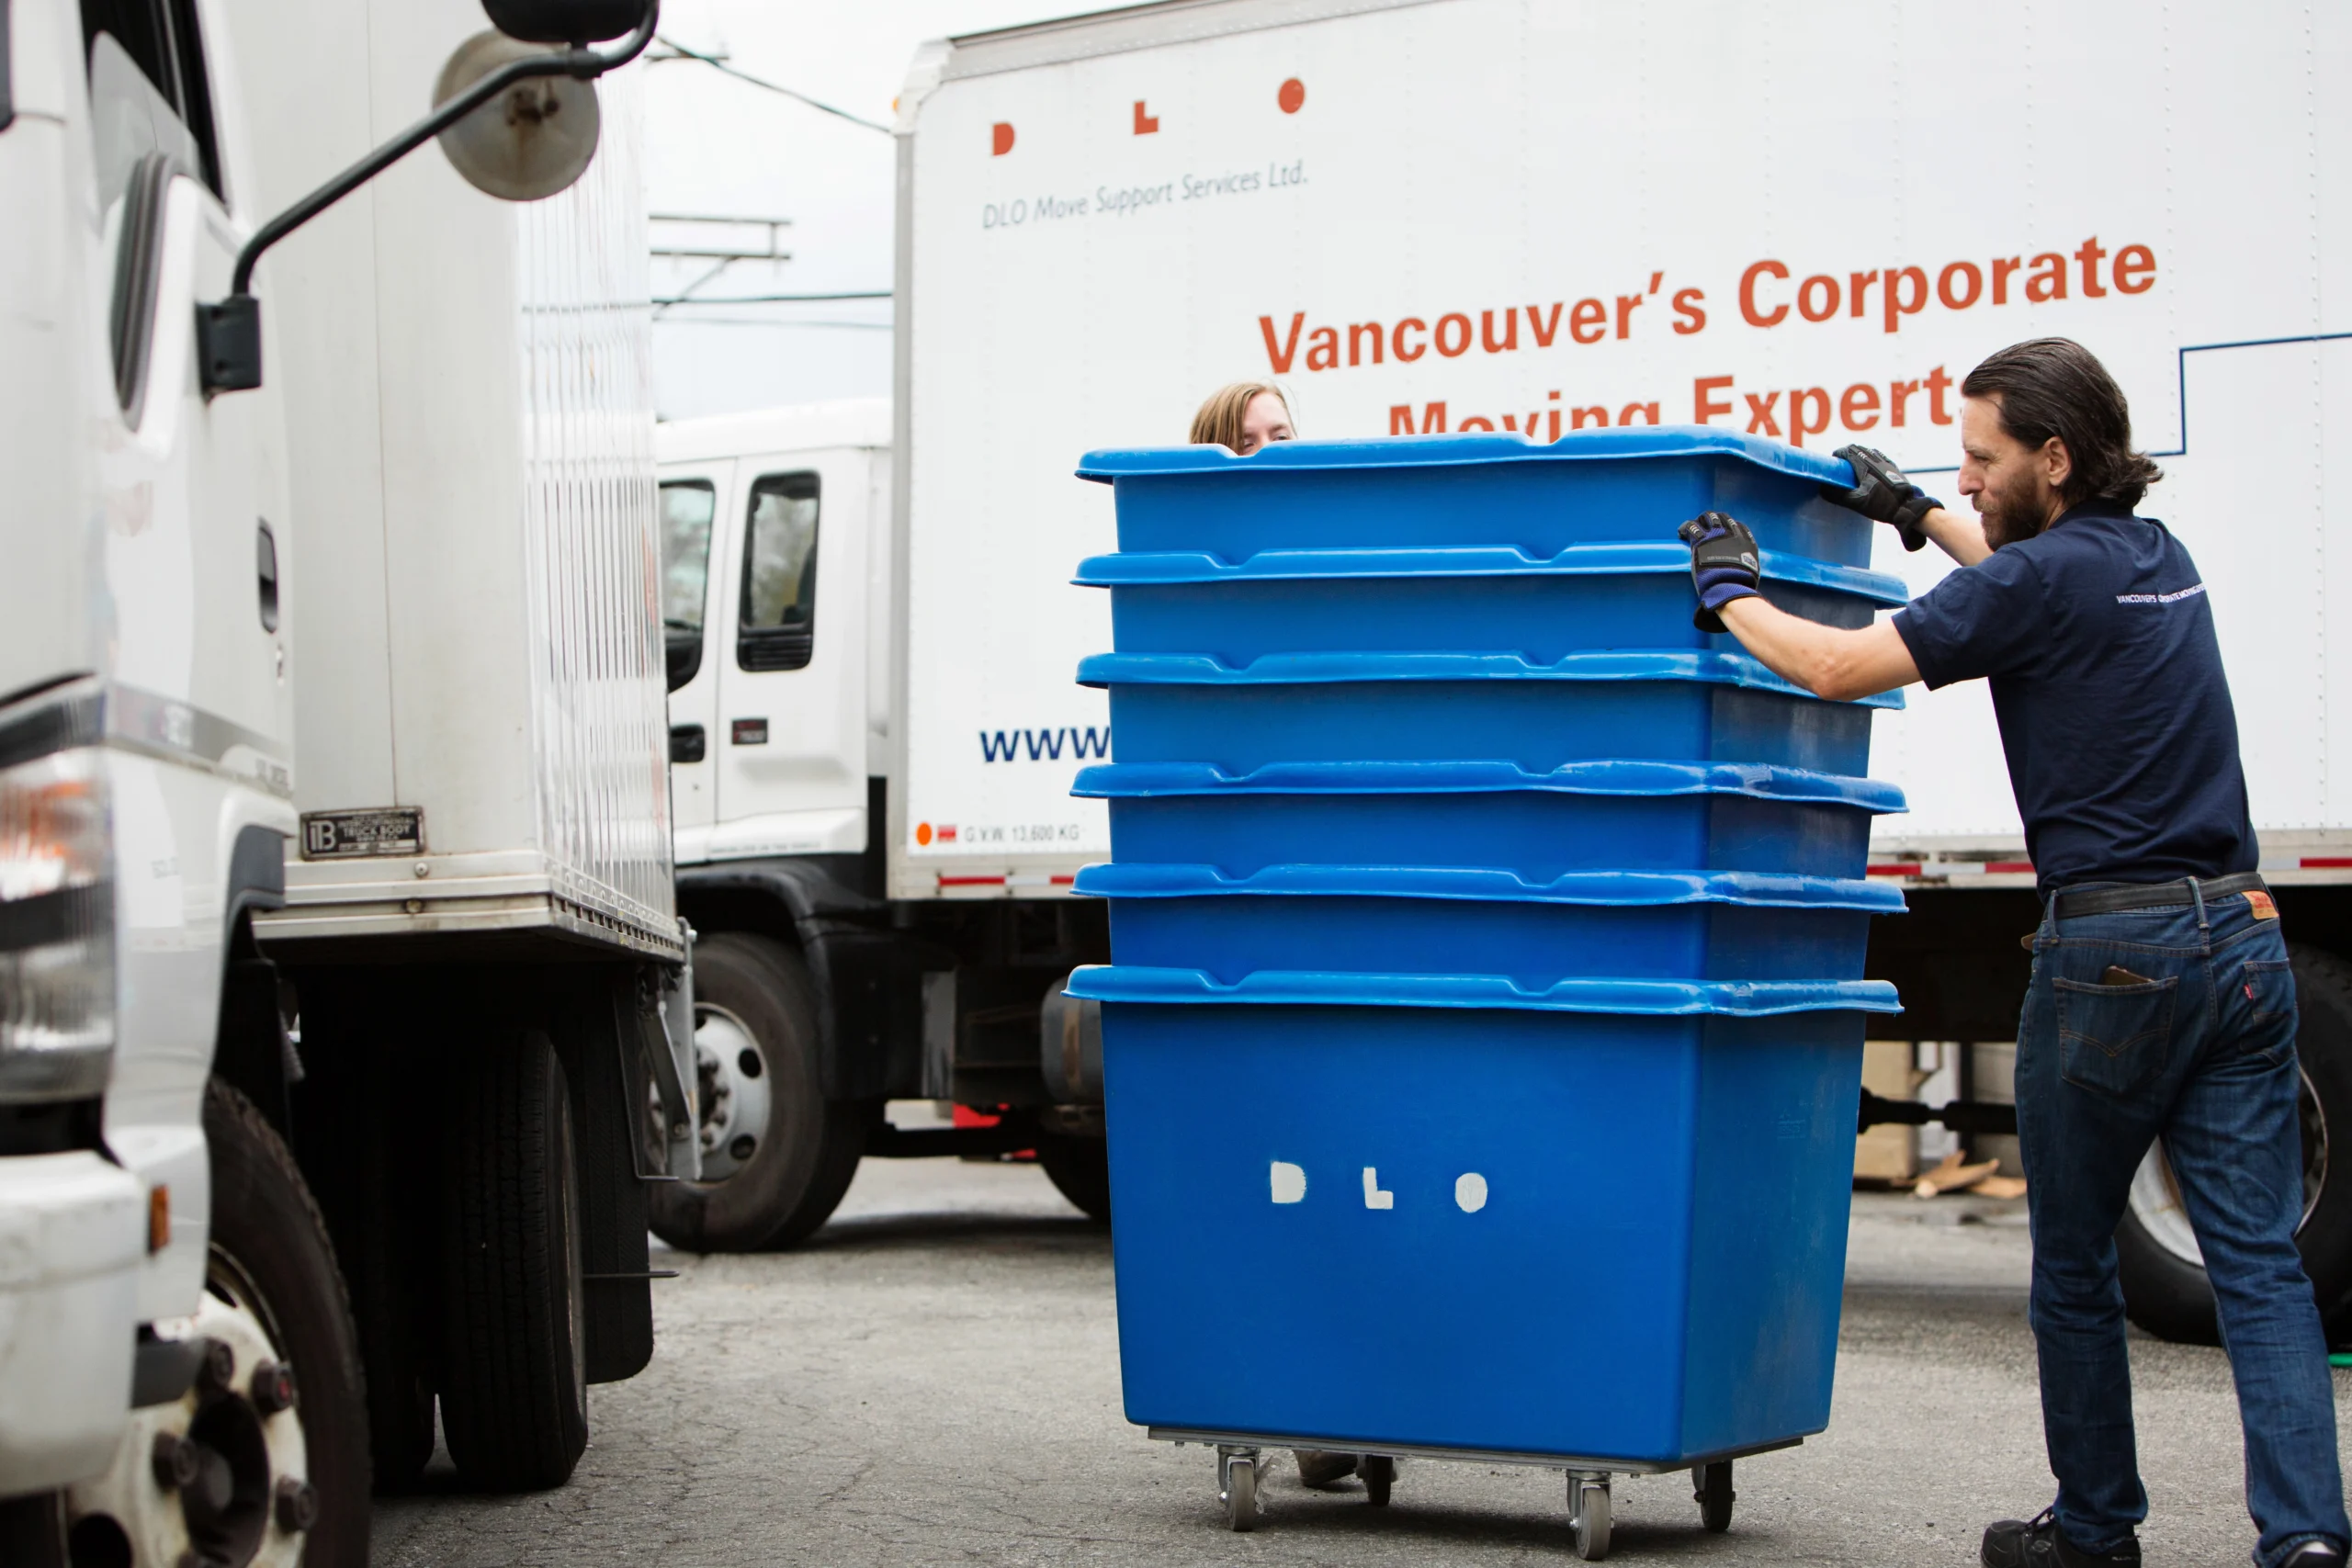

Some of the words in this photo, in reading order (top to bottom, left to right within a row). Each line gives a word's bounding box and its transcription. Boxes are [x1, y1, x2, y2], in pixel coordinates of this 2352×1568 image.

[982, 199, 1028, 230] DLO
[1034, 194, 1089, 222] Move
[1095, 183, 1174, 217] Support
[1181, 171, 1261, 201] Services
[1268, 158, 1309, 187] Ltd.
[1258, 271, 1707, 376] Vancouver's
[1738, 235, 2156, 333] Corporate
[1693, 365, 1963, 447] Expert
[343, 825, 378, 838] TRUCK
[379, 824, 411, 836] BODY
